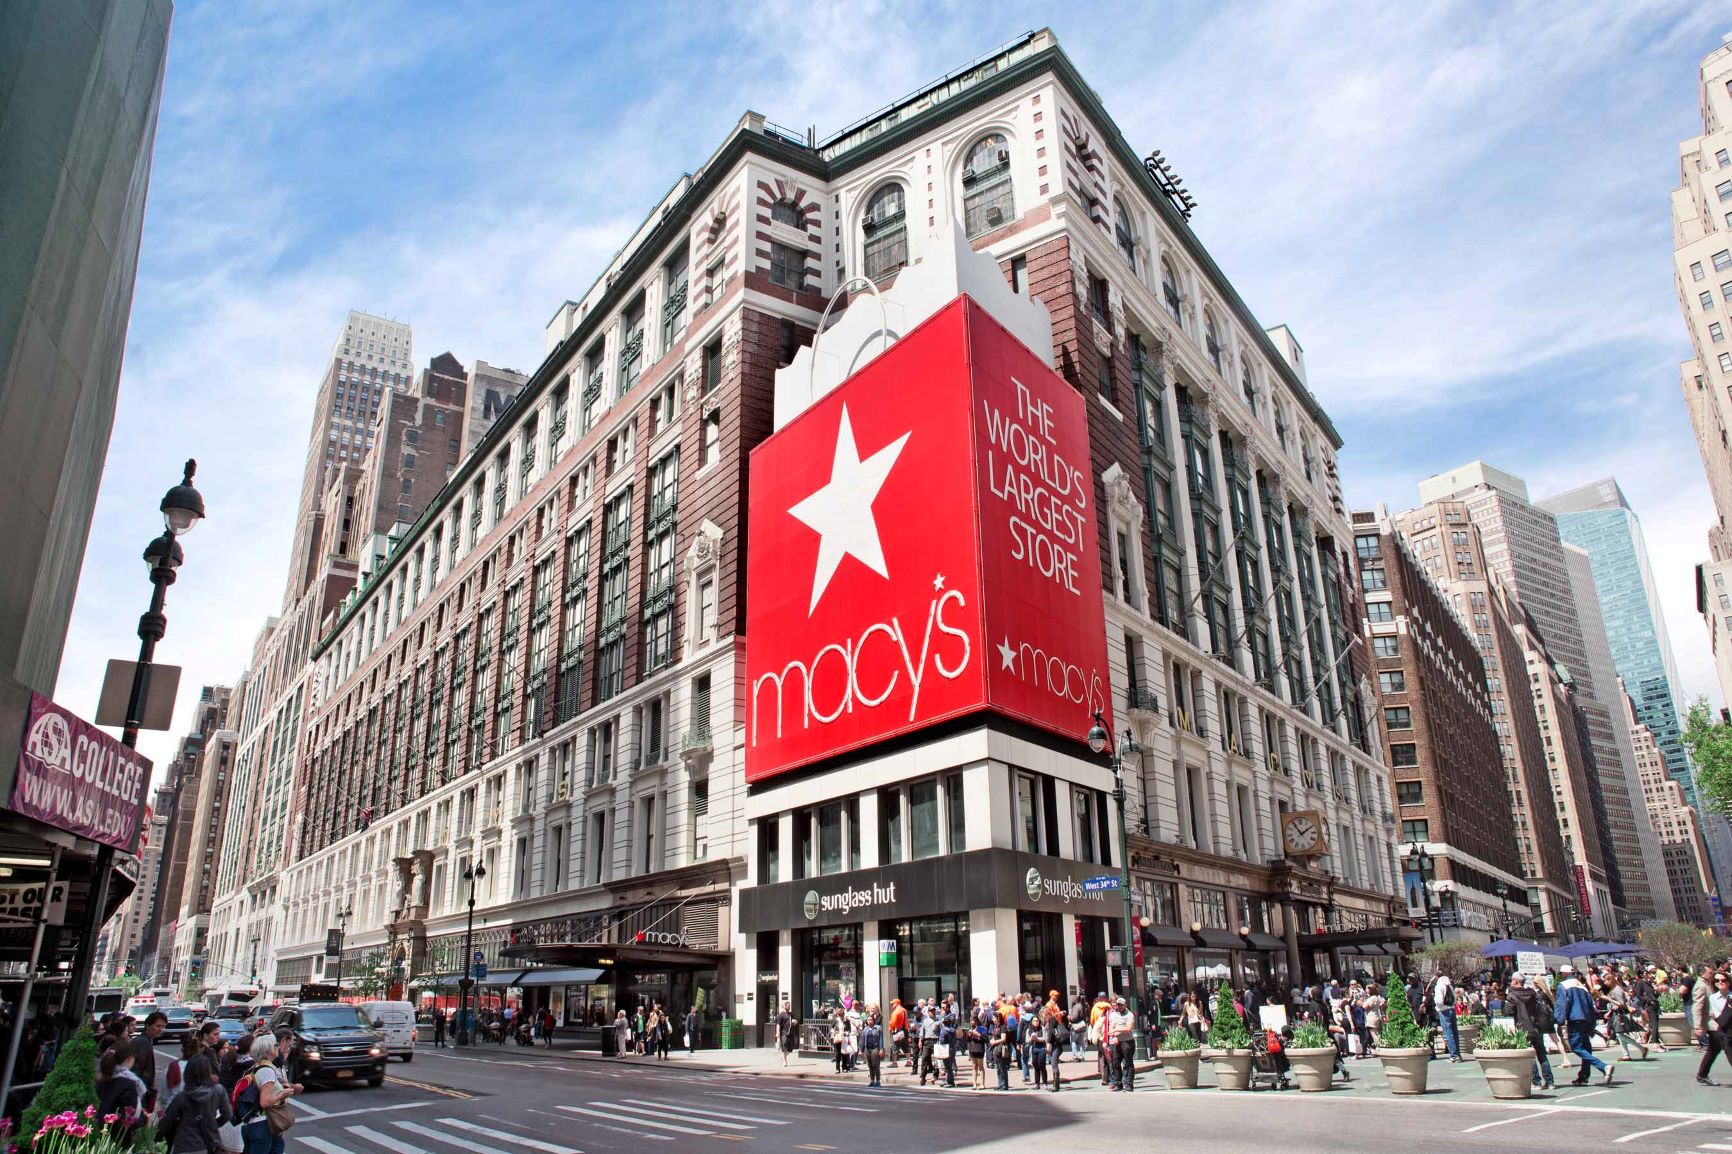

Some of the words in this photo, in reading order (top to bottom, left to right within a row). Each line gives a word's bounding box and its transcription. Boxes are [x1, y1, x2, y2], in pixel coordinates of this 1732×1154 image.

[1011, 376, 1056, 445] THE
[984, 399, 1086, 509] WORLD'S
[989, 450, 1086, 552] LARGEST
[1009, 516, 1081, 596] STORE
[26, 713, 72, 770] ASA
[72, 735, 143, 805] COLLEGE
[24, 772, 131, 840] WWW.ASA.EDU
[821, 886, 872, 914] sunglass
[874, 882, 896, 904] hut
[1085, 882, 1099, 890] West
[1100, 880, 1110, 889] 34th
[1111, 880, 1118, 888] St
